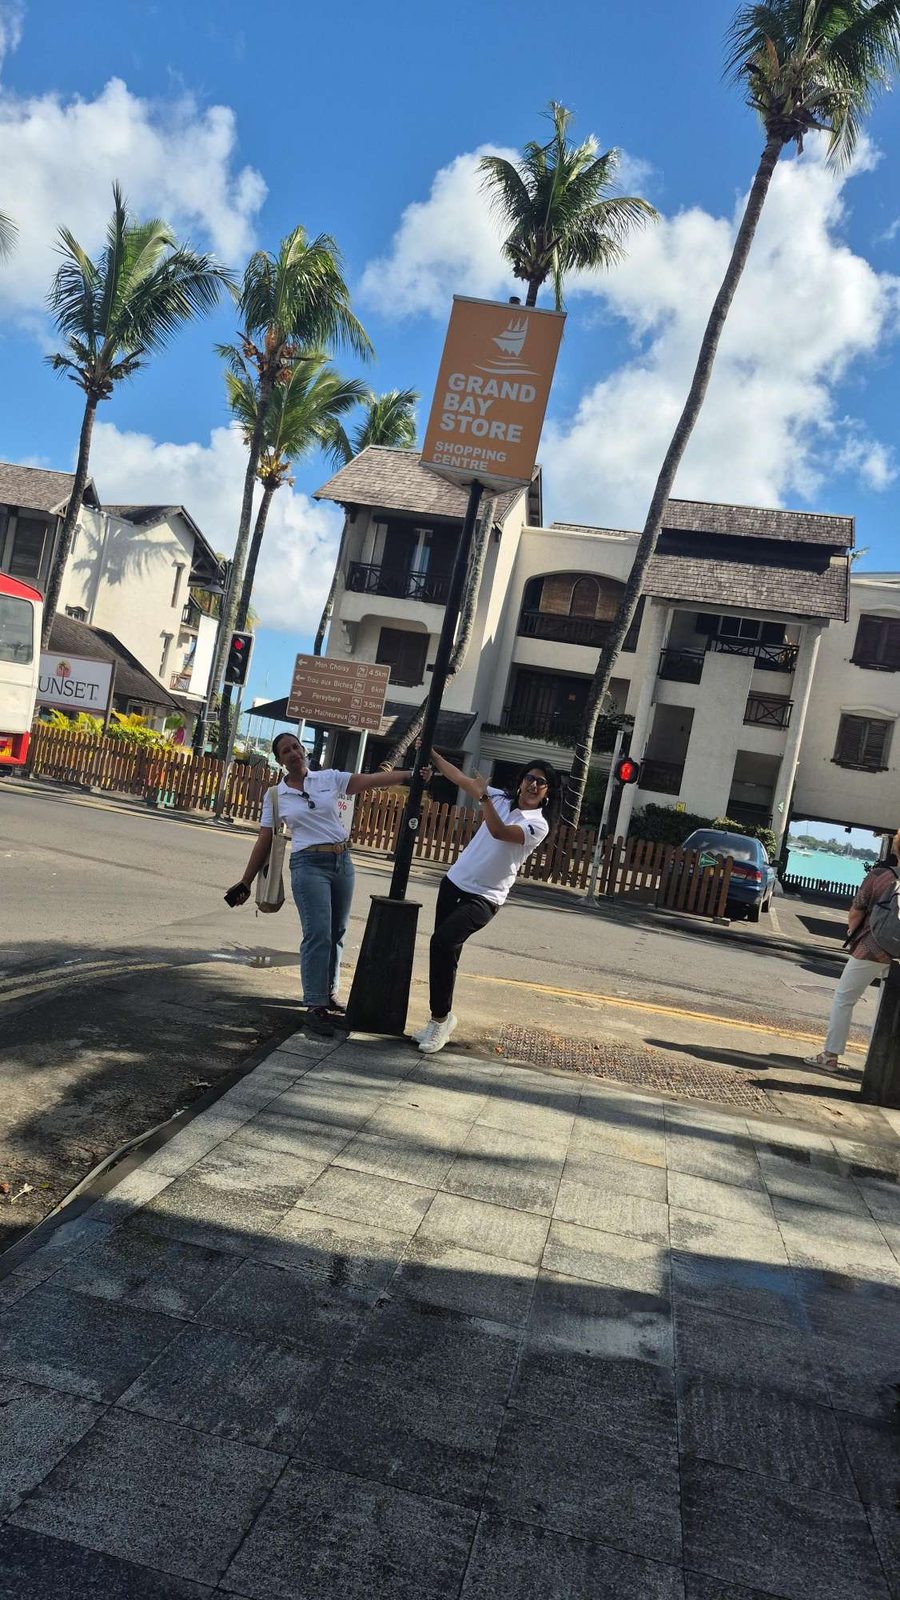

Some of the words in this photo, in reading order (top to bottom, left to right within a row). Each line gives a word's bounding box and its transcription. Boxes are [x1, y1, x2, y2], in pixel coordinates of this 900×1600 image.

[448, 373, 536, 403] GRAND
[444, 393, 495, 416] BAY
[440, 413, 524, 443] STORE
[434, 440, 507, 462] SHOPPING
[432, 454, 488, 472] CENTRE
[38, 675, 99, 701] UNSET
[300, 706, 312, 714] Cap
